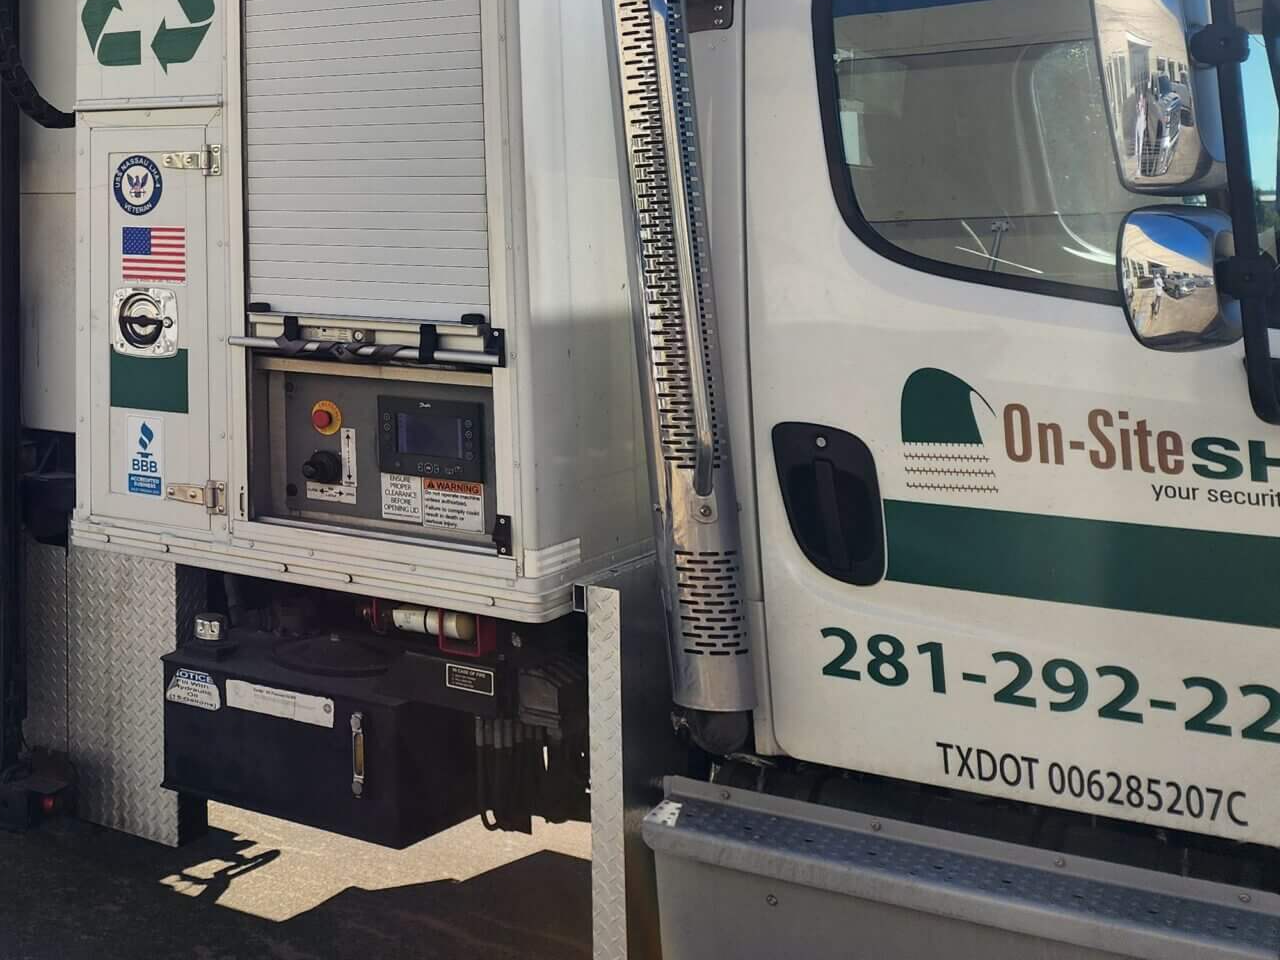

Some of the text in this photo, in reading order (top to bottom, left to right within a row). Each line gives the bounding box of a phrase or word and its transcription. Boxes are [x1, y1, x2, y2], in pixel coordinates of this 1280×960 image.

[132, 459, 157, 472] BBB
[390, 482, 412, 490] PROPER
[436, 482, 480, 494] WARNING
[1151, 484, 1199, 501] your
[391, 497, 412, 505] BEFORE
[820, 627, 1280, 745] 281-292-22
[935, 742, 1249, 827] TXDOT 006285207C
